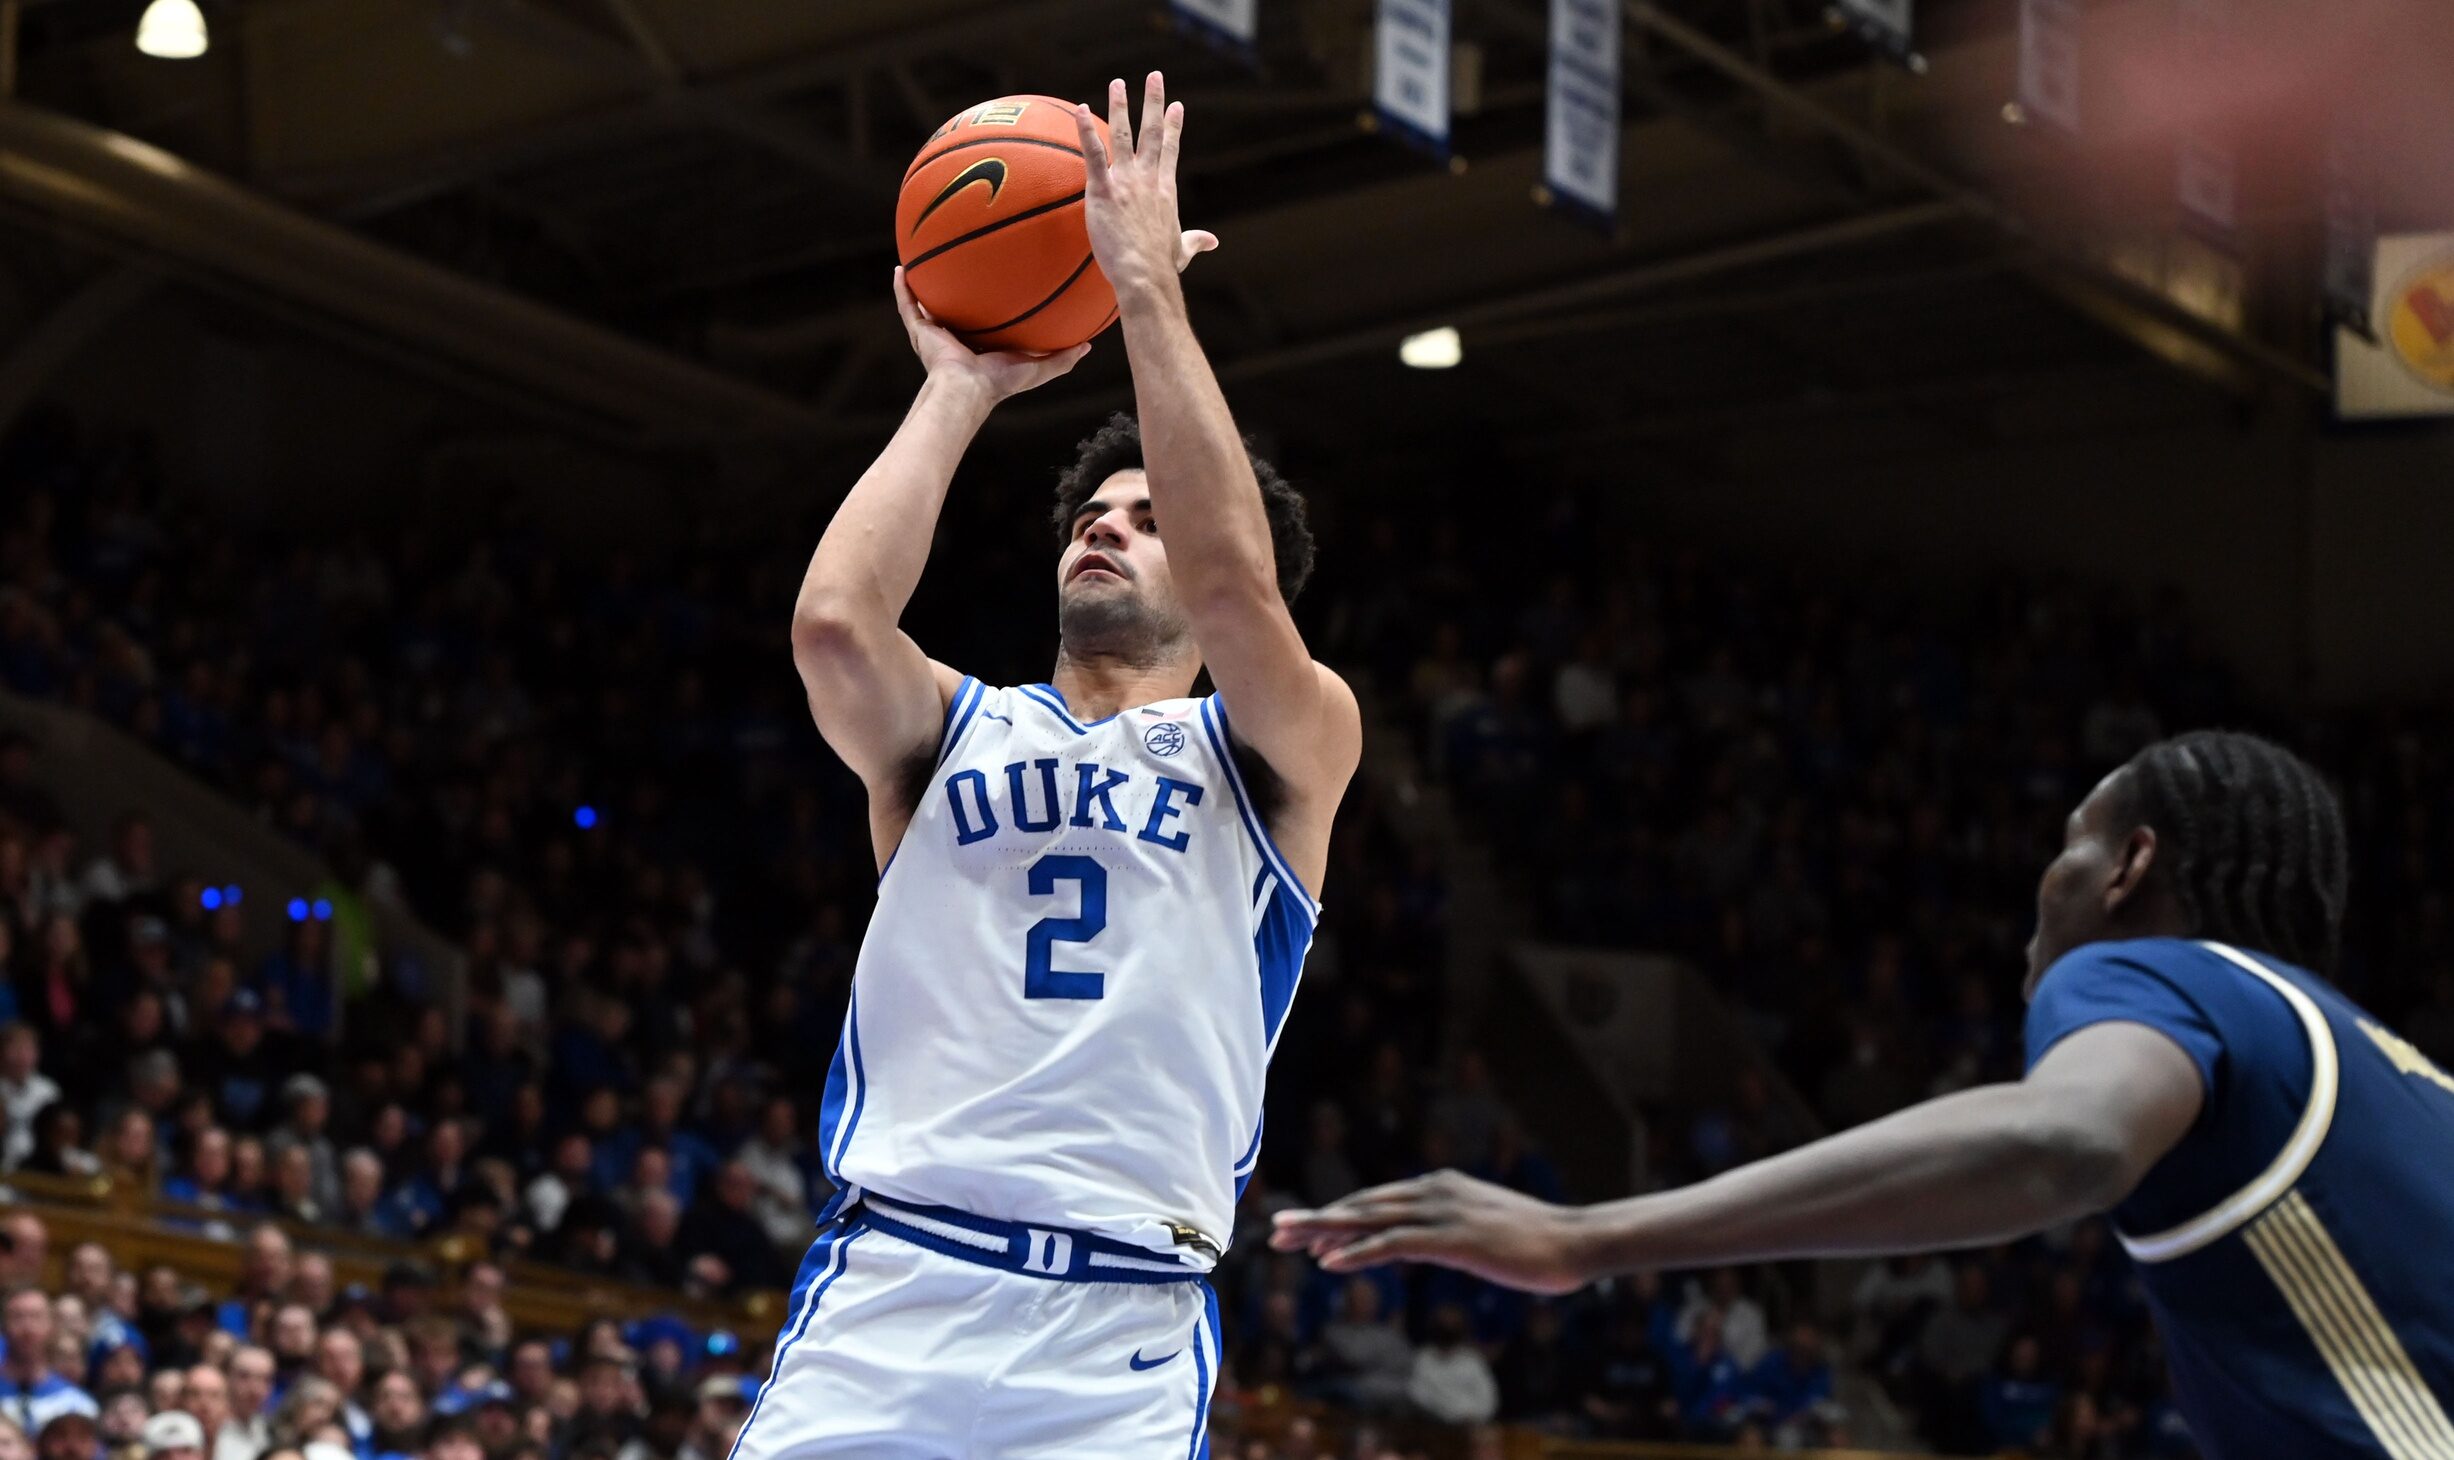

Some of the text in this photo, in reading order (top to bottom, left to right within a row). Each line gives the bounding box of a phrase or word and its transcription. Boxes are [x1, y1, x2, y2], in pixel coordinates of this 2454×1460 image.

[1150, 732, 1181, 743] ACC
[945, 758, 1204, 853] DUKE
[1024, 855, 1107, 1000] 2
[1022, 1229, 1073, 1275] D
